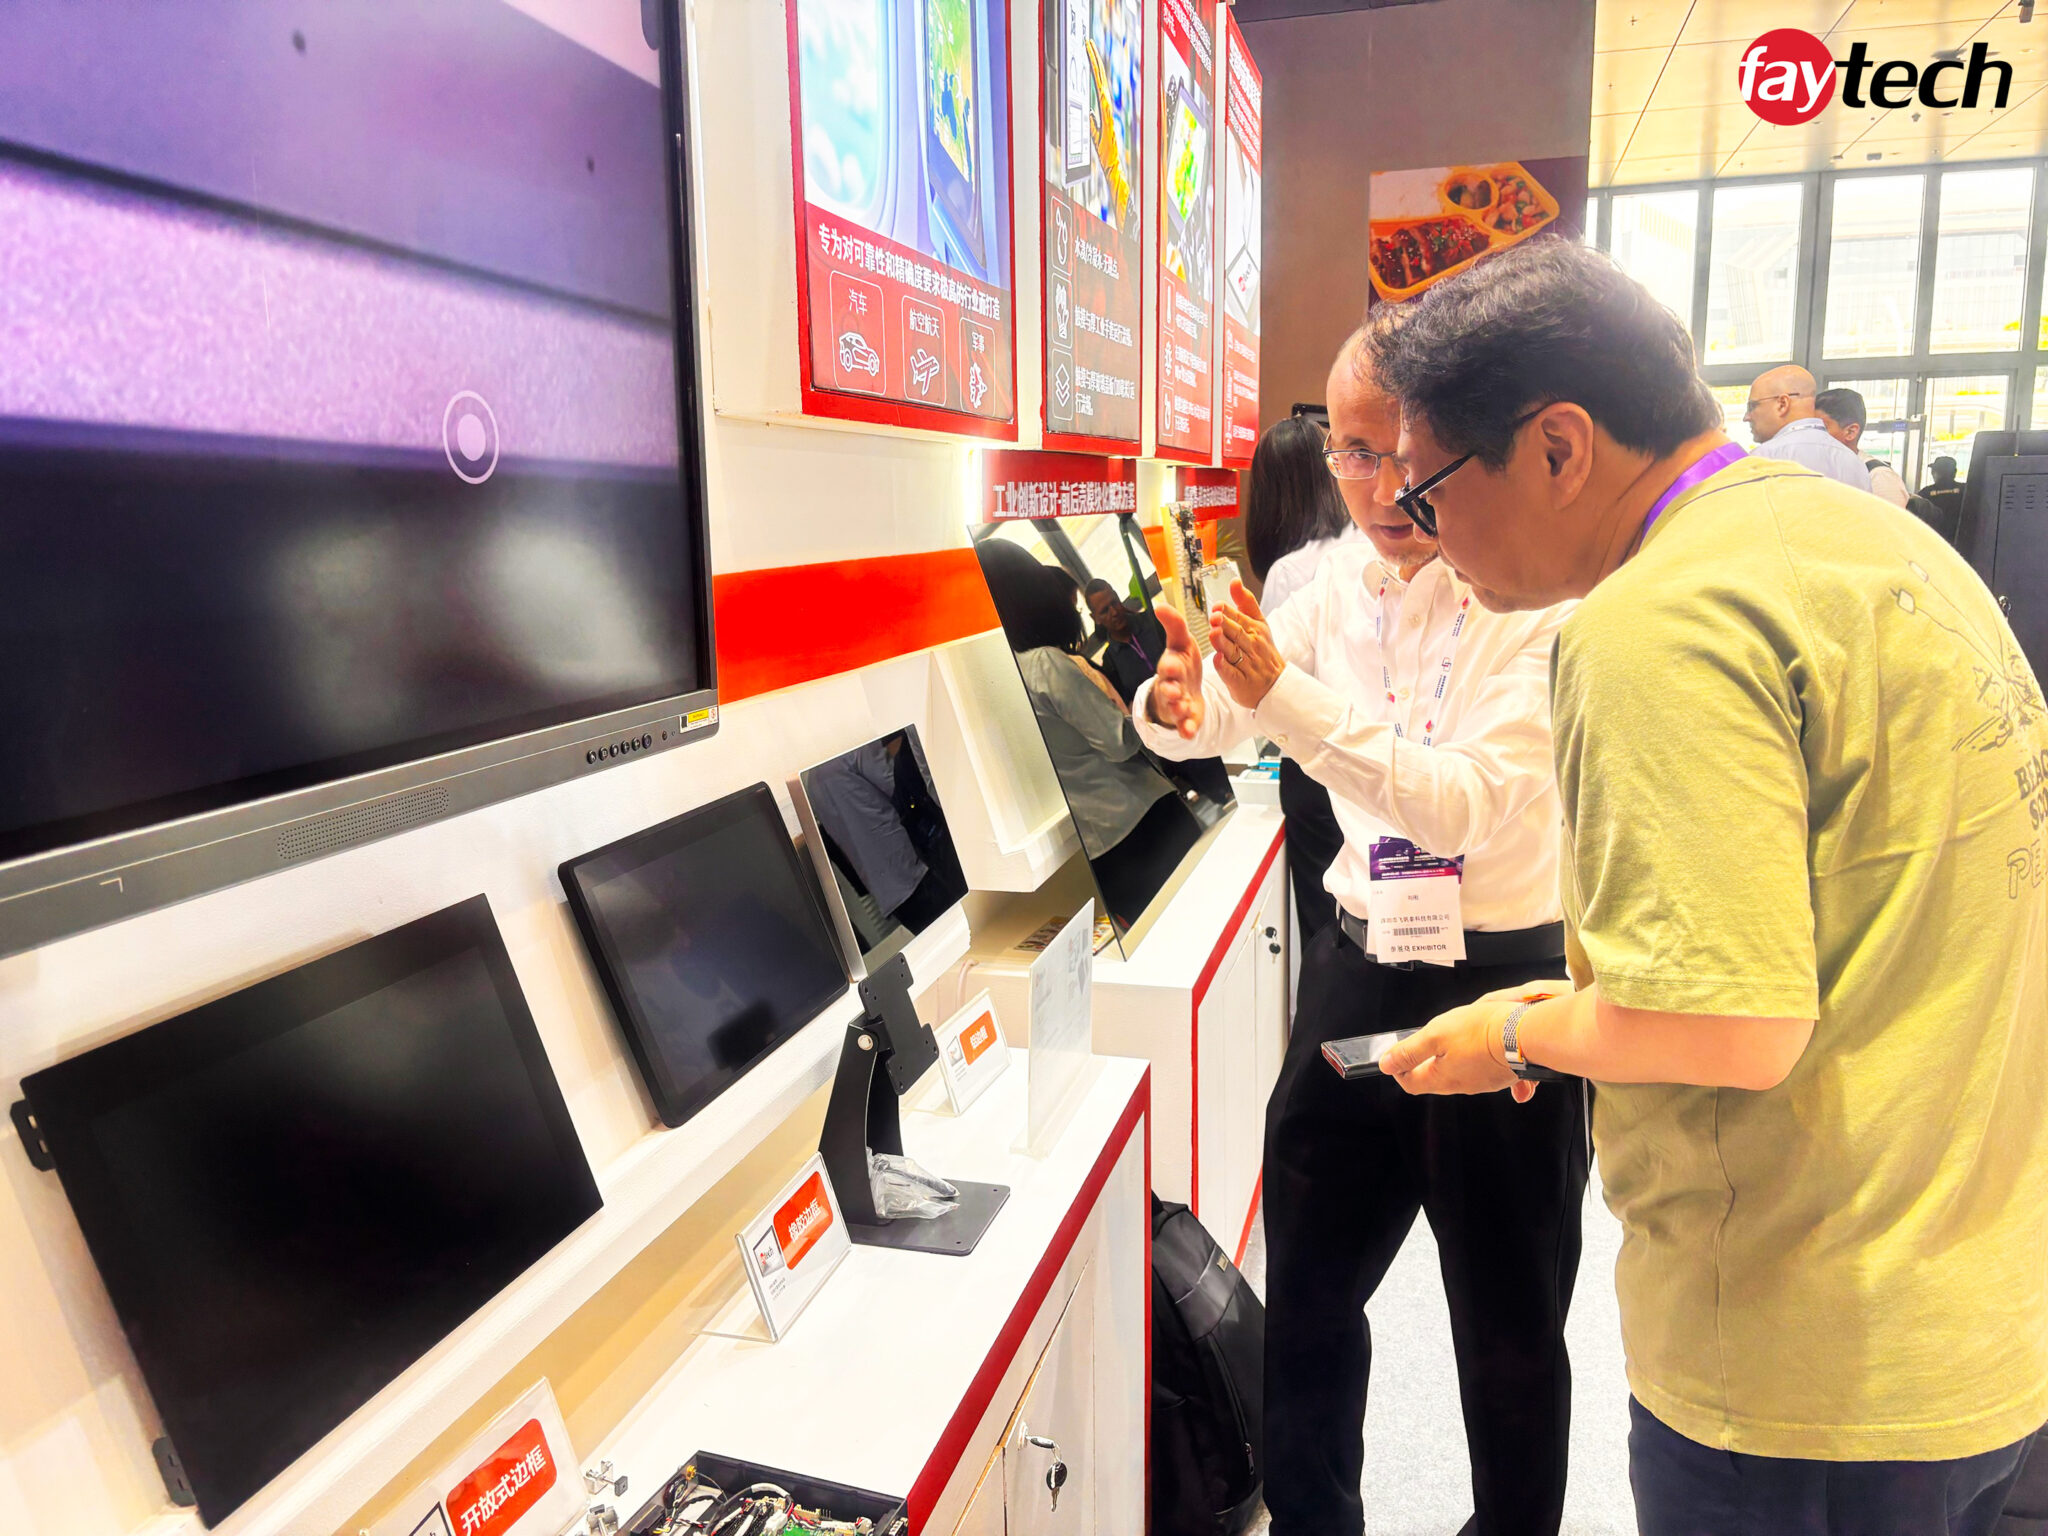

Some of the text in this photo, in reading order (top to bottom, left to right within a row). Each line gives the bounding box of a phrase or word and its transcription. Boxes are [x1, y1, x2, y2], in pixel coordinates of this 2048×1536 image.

[848, 288, 868, 316] 汽车
[909, 308, 940, 339] 航空航天
[1412, 944, 1447, 952] EXHIBITOR
[460, 1444, 546, 1535] 开放式边框
